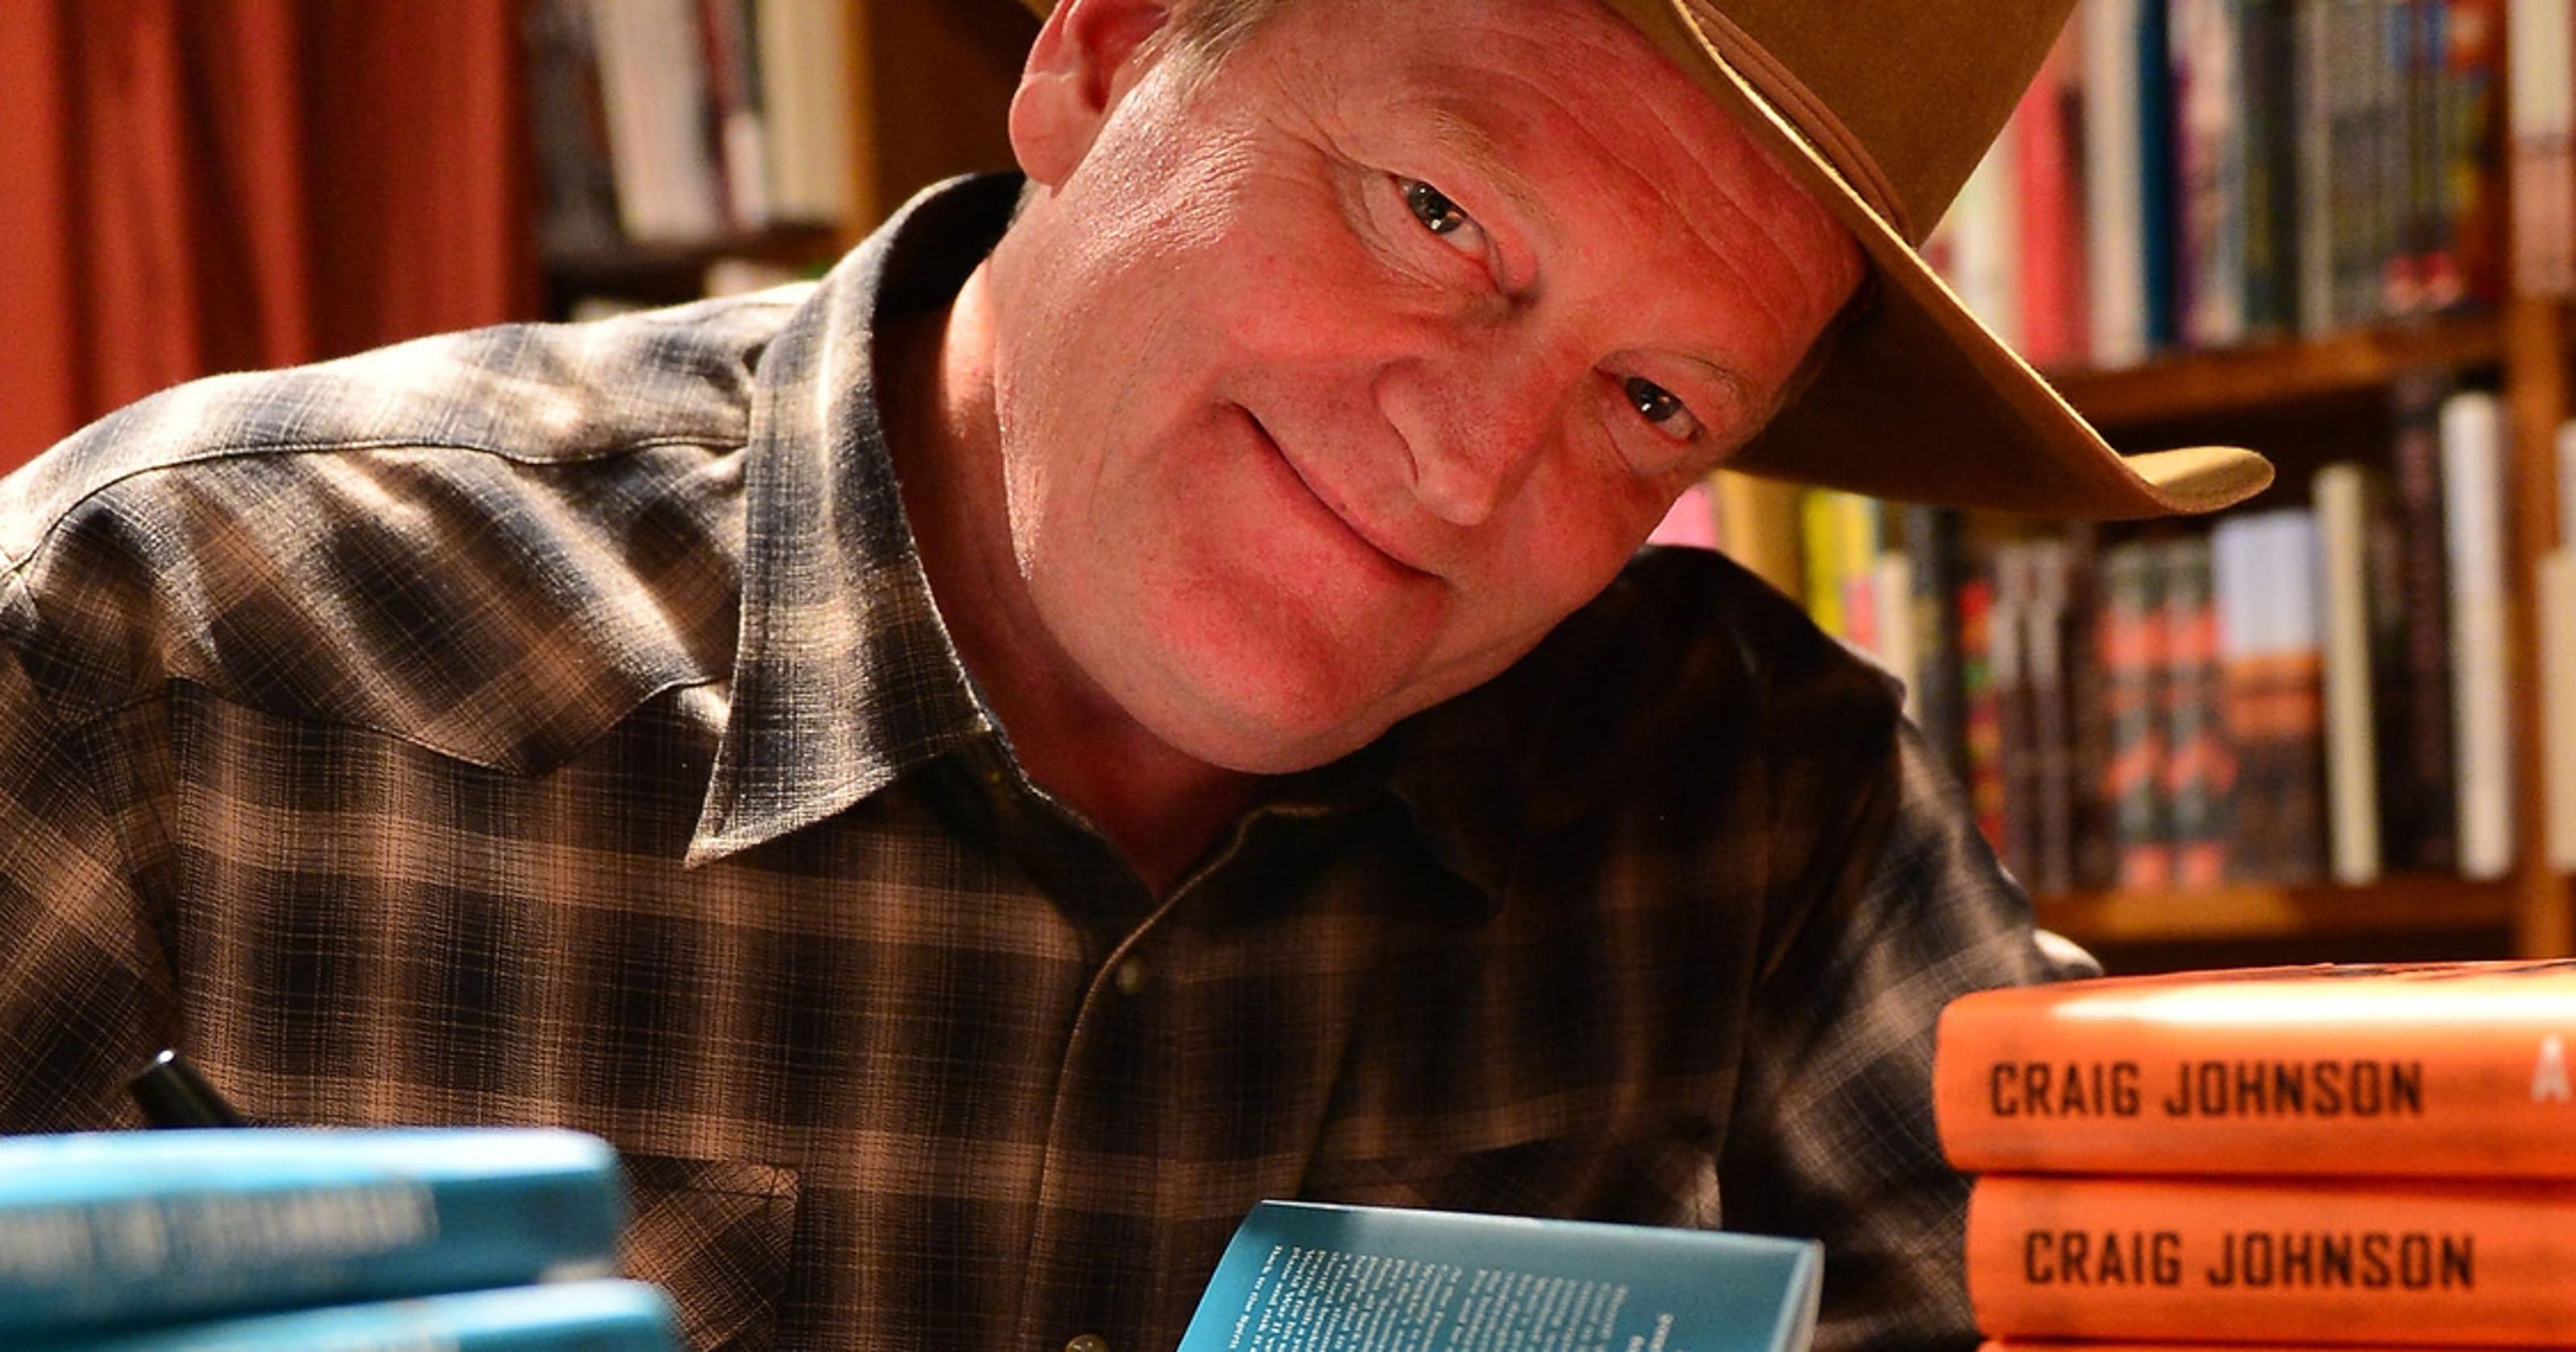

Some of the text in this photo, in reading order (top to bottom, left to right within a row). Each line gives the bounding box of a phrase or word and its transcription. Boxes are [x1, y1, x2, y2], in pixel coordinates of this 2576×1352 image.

[1990, 1033, 2573, 1118] CRAIG JOHNSON A
[2023, 1230, 2476, 1289] CRAIG JOHNSON
